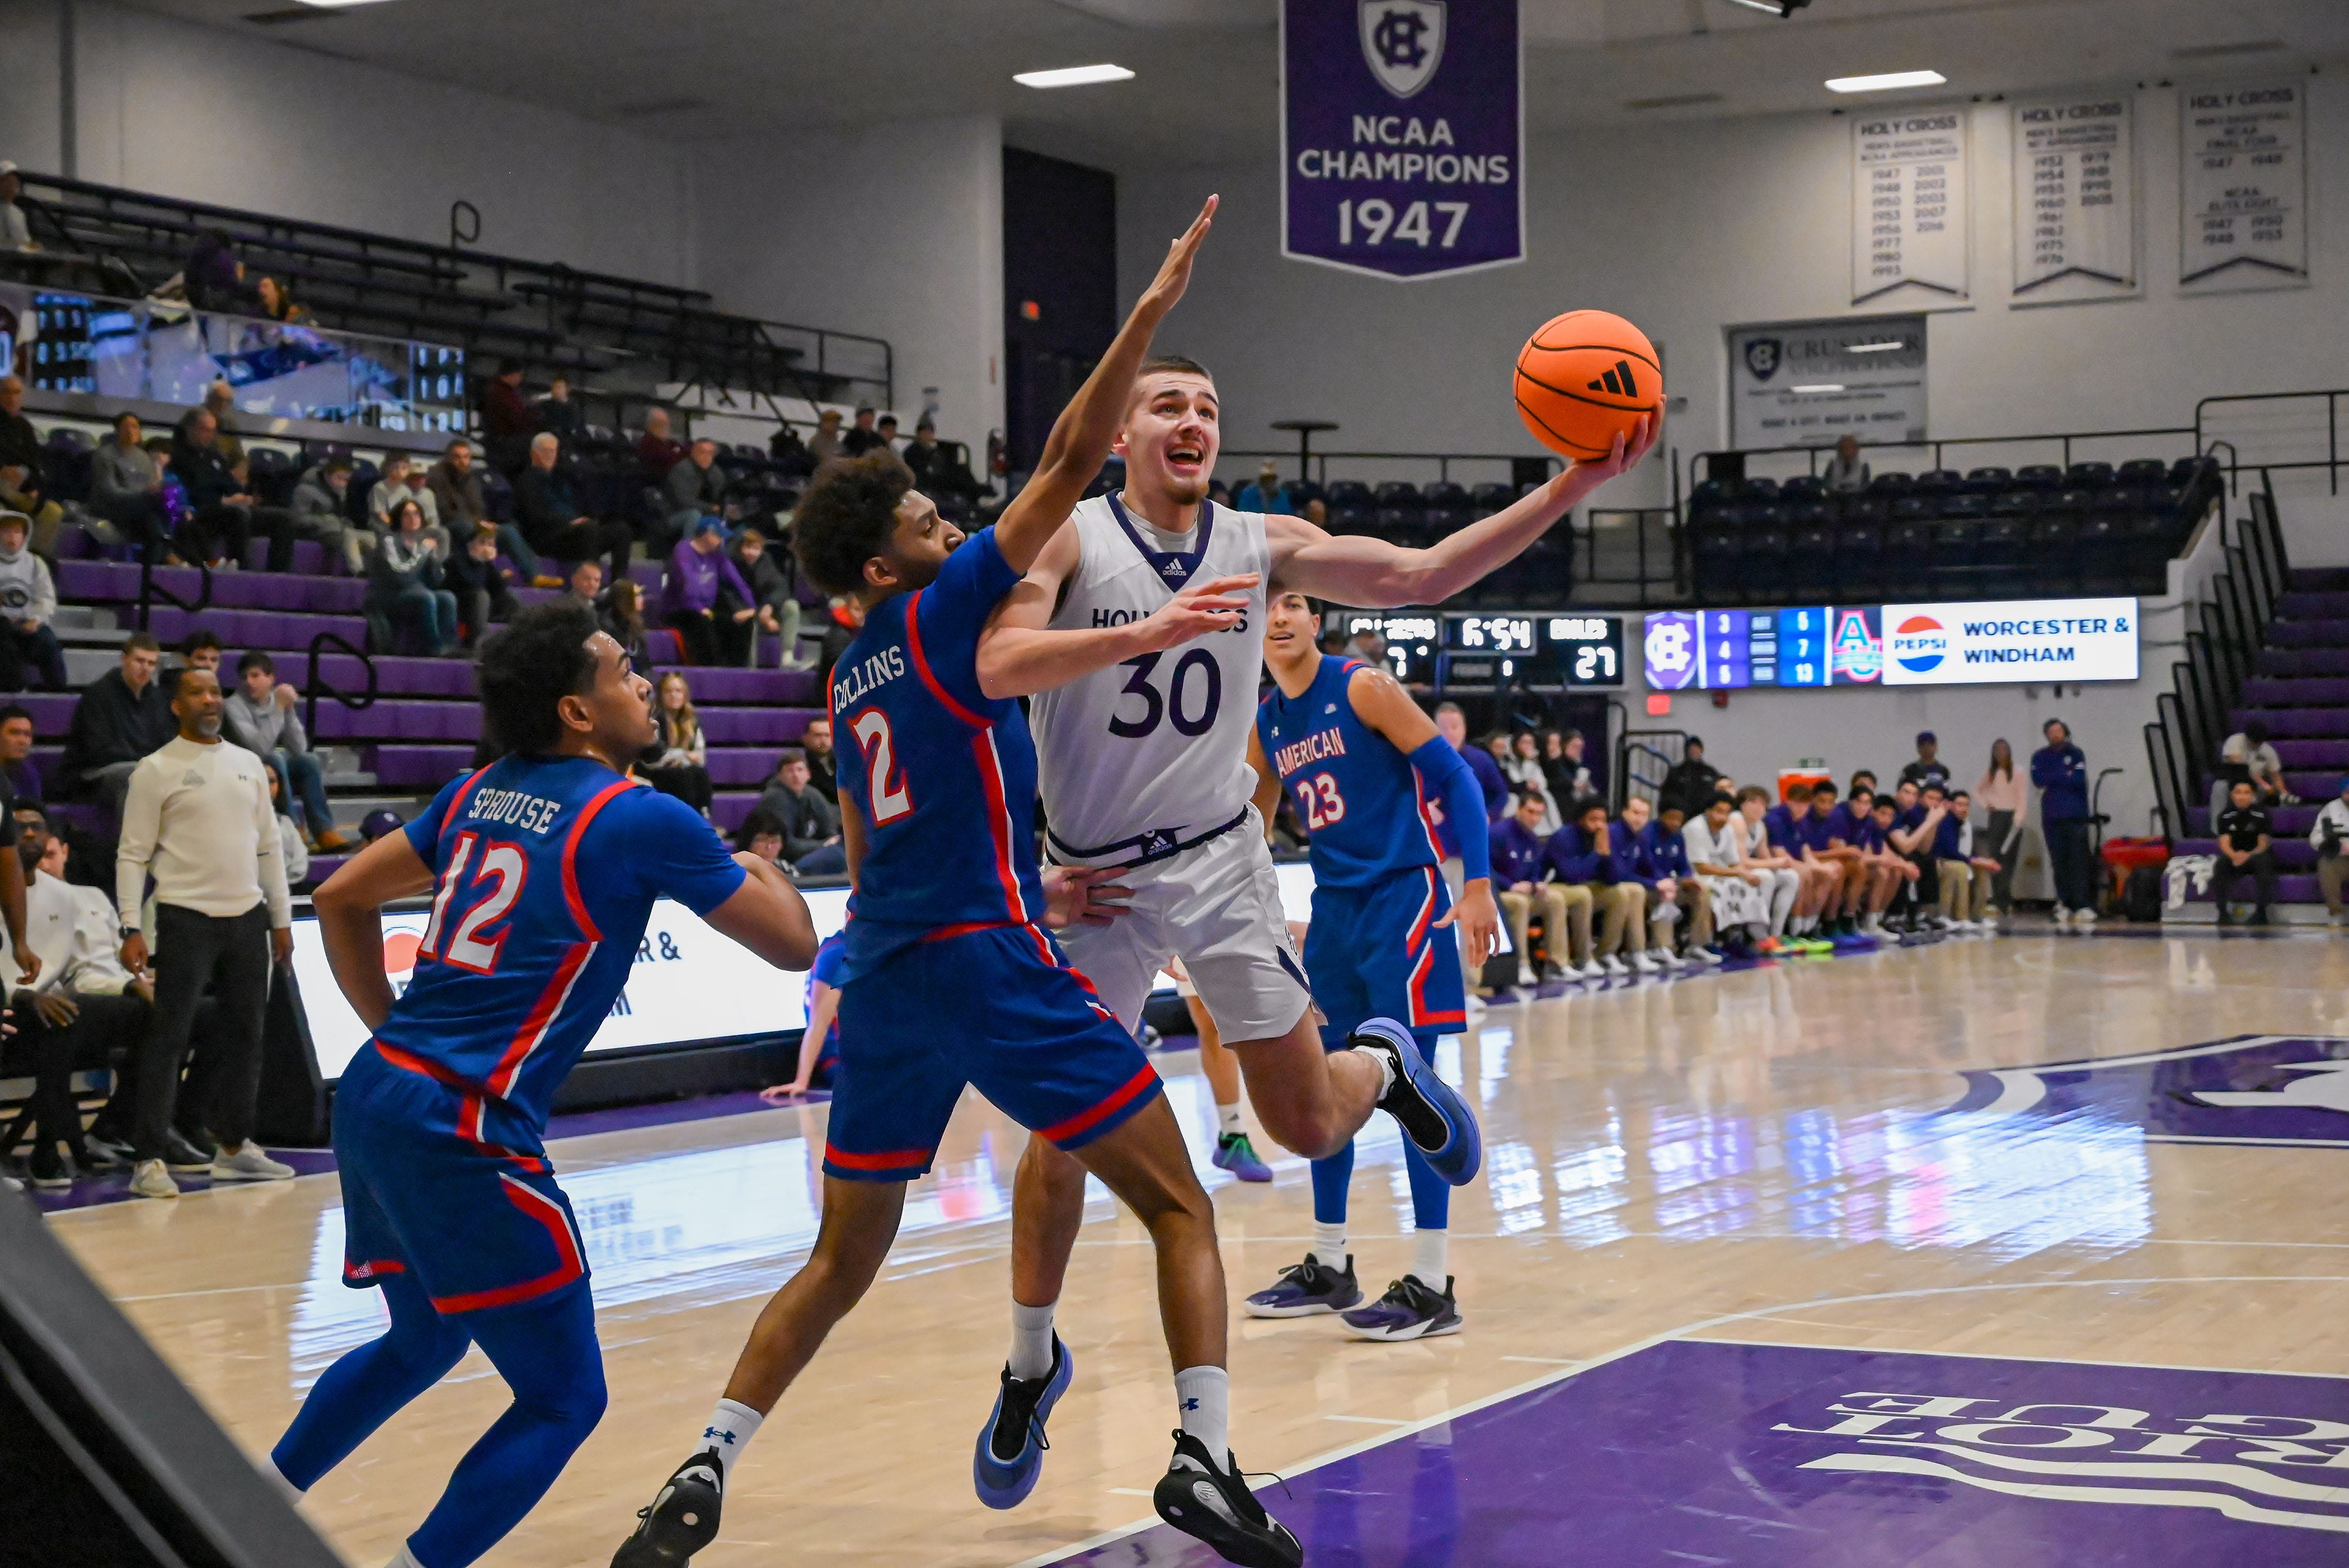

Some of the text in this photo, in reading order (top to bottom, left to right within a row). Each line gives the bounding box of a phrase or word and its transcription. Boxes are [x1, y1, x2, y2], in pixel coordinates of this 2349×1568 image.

[1353, 115, 1454, 146] NCAA
[1861, 115, 1957, 135] HOLY CROSS
[1297, 149, 1510, 184] CHAMPIONS
[1338, 198, 1469, 248] 1947
[1092, 608, 1150, 629] HO
[1964, 617, 2129, 636] WORCESTER &
[1798, 638, 1809, 658] 7
[1894, 639, 1947, 650] PEPSI
[1964, 647, 2075, 663] WINDHAM
[1576, 647, 1615, 679] 27
[833, 645, 904, 714] COLLINS
[1108, 648, 1221, 738] 30
[849, 706, 914, 826] 2
[1274, 727, 1346, 779] AMERICAN
[468, 788, 561, 835] SPROUSE
[1297, 772, 1345, 830] 23
[1148, 843, 1173, 855] adidas
[417, 832, 527, 974] 12
[658, 931, 682, 960] &
